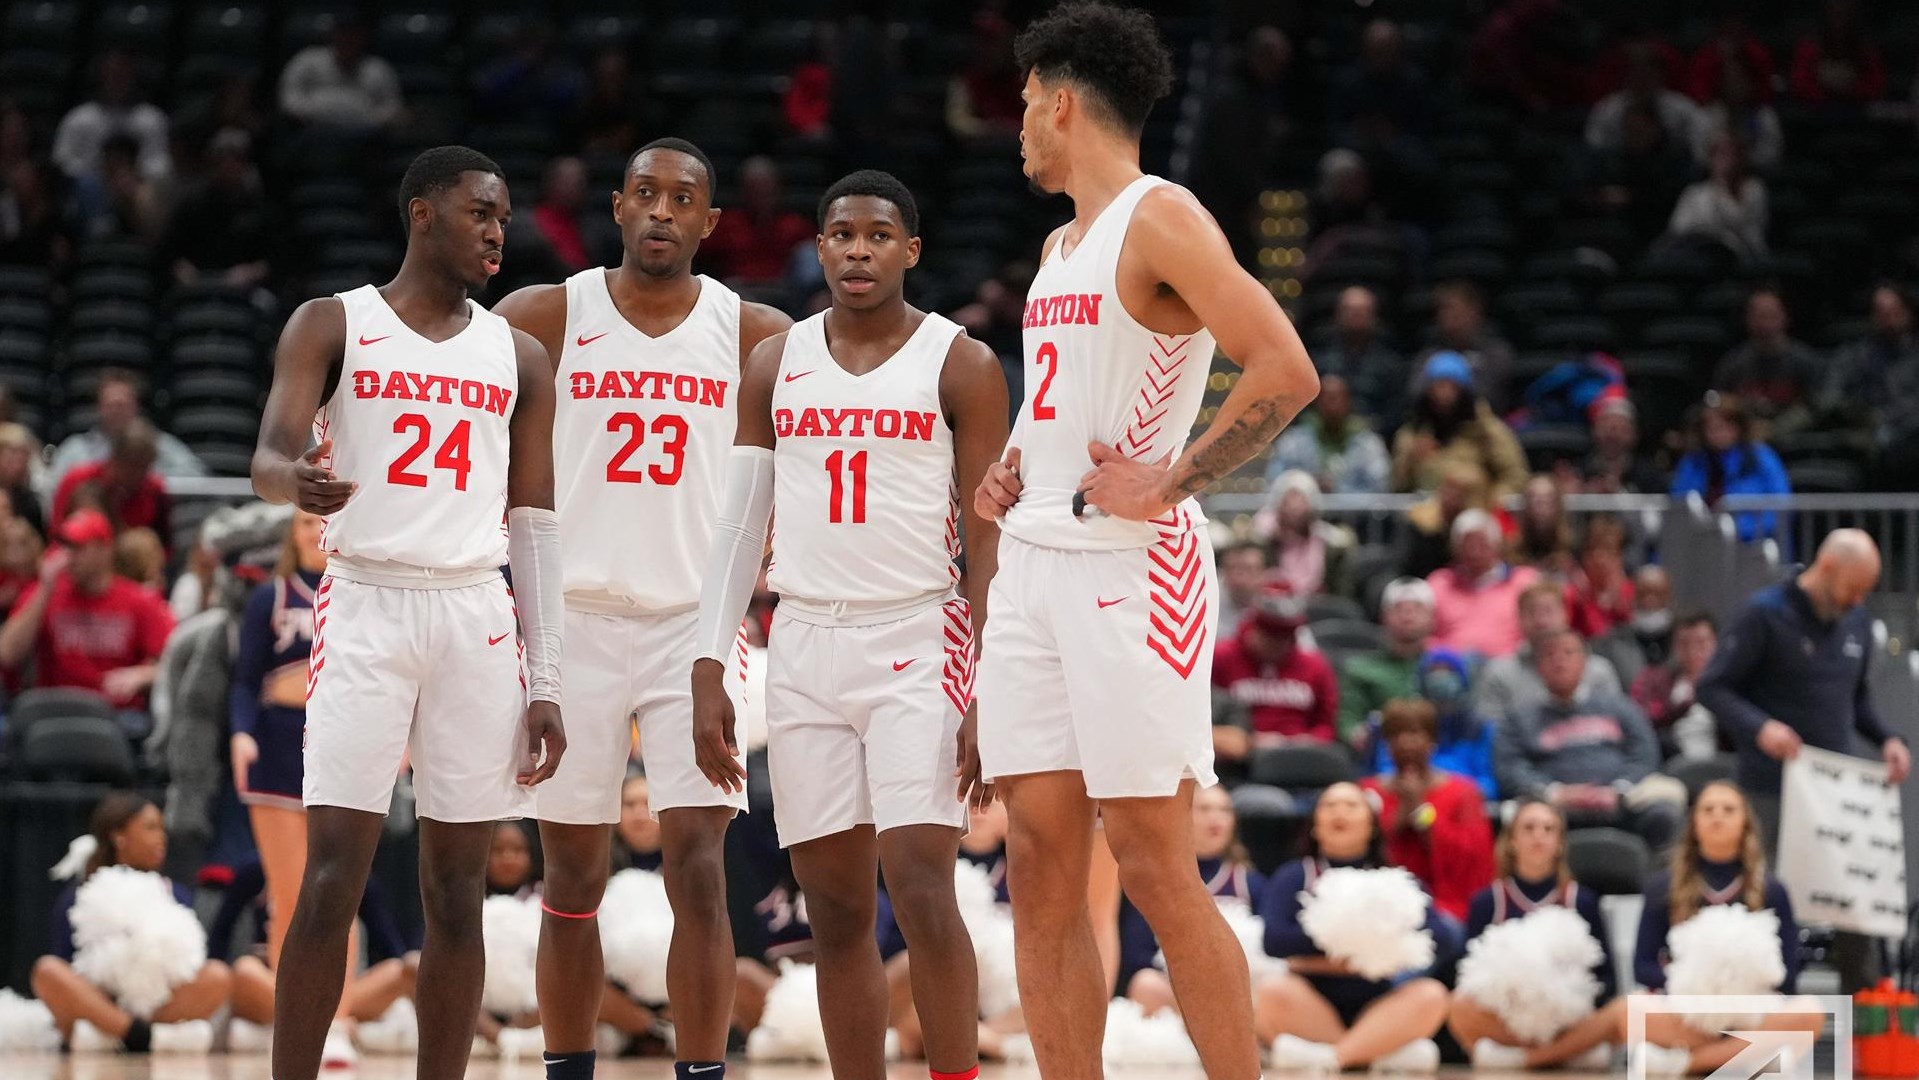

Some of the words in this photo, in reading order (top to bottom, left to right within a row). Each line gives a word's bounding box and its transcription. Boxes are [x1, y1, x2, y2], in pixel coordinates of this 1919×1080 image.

[352, 370, 512, 417] DAYTON
[569, 370, 728, 409] DAYTON
[1033, 342, 1058, 421] 2
[387, 413, 472, 492] 24
[606, 412, 689, 486] 23
[775, 408, 937, 442] DAYTON
[825, 449, 868, 524] 11
